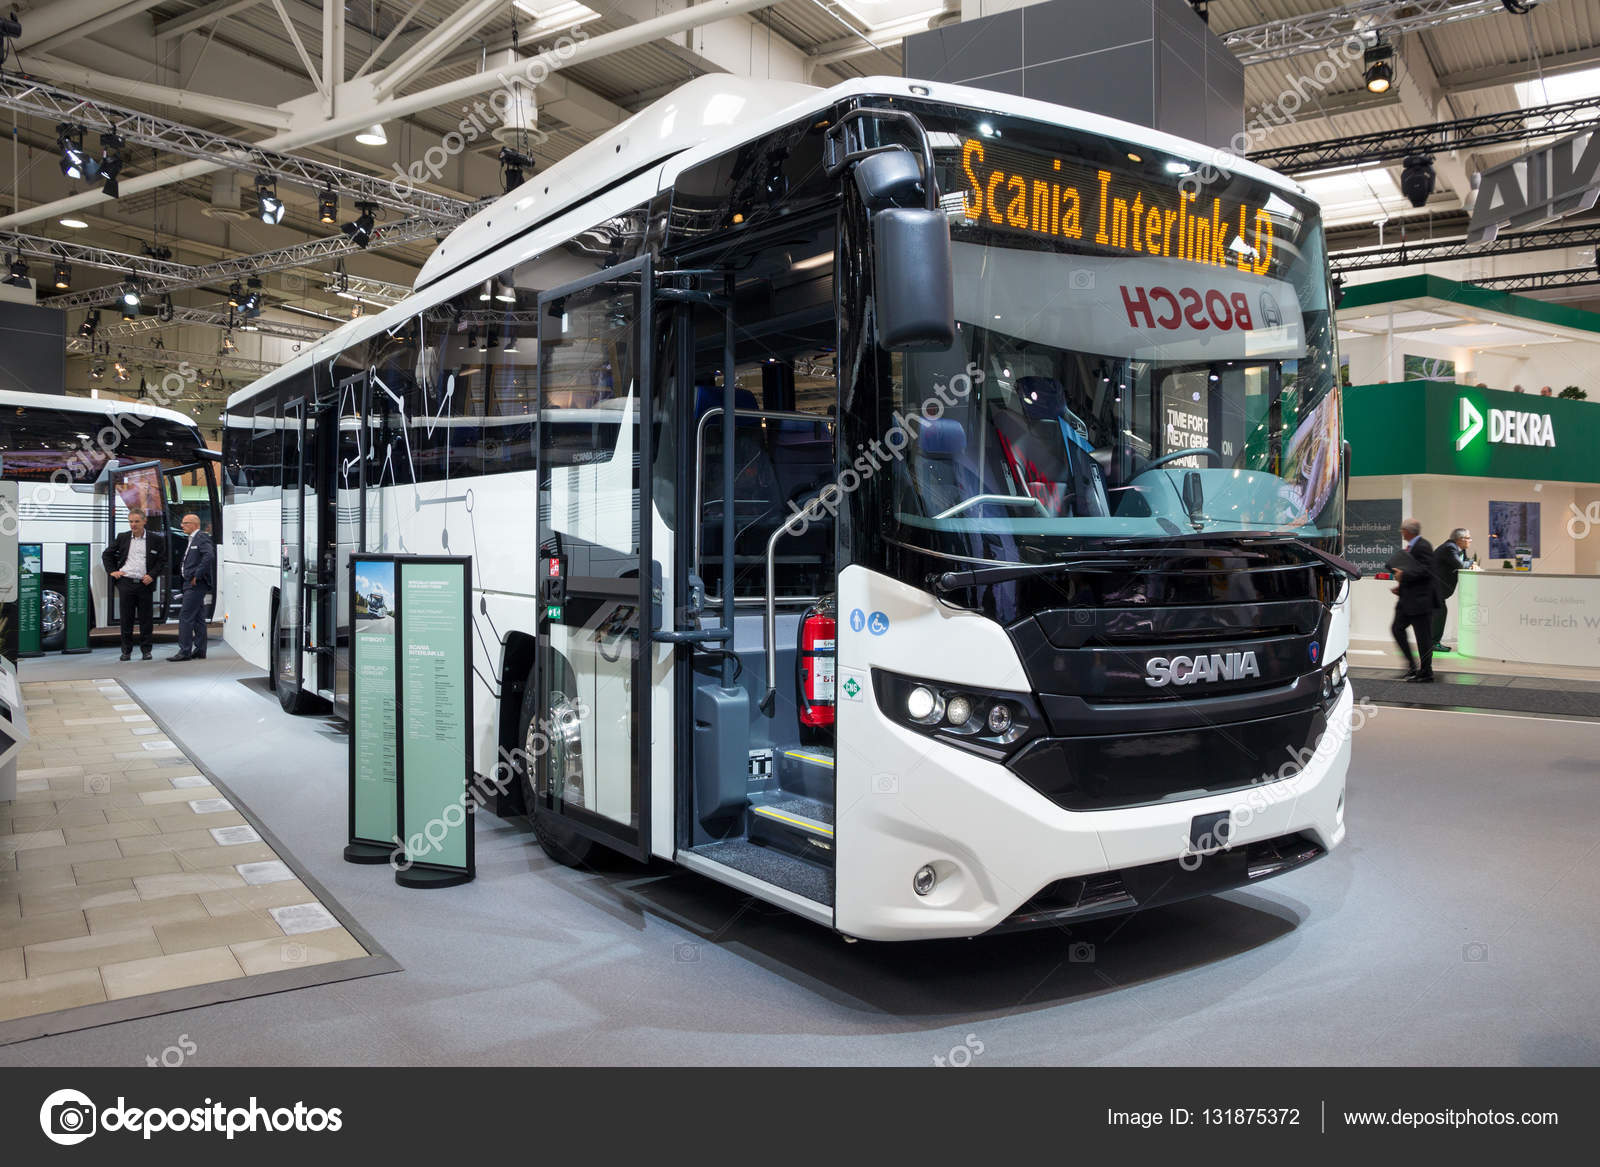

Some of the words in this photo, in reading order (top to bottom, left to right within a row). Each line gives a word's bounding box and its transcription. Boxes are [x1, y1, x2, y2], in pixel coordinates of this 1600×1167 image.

[962, 138, 1083, 239] Scania
[1095, 170, 1229, 268] Interlink
[1236, 204, 1273, 276] LD
[1167, 409, 1187, 429] TIME
[1187, 413, 1204, 433] FOR
[1487, 408, 1556, 447] DEKRA
[1167, 426, 1190, 448] NEXT
[1347, 544, 1393, 554] Sicherheit
[1519, 613, 1578, 628] Herzlich
[1144, 651, 1261, 688] SCANIA
